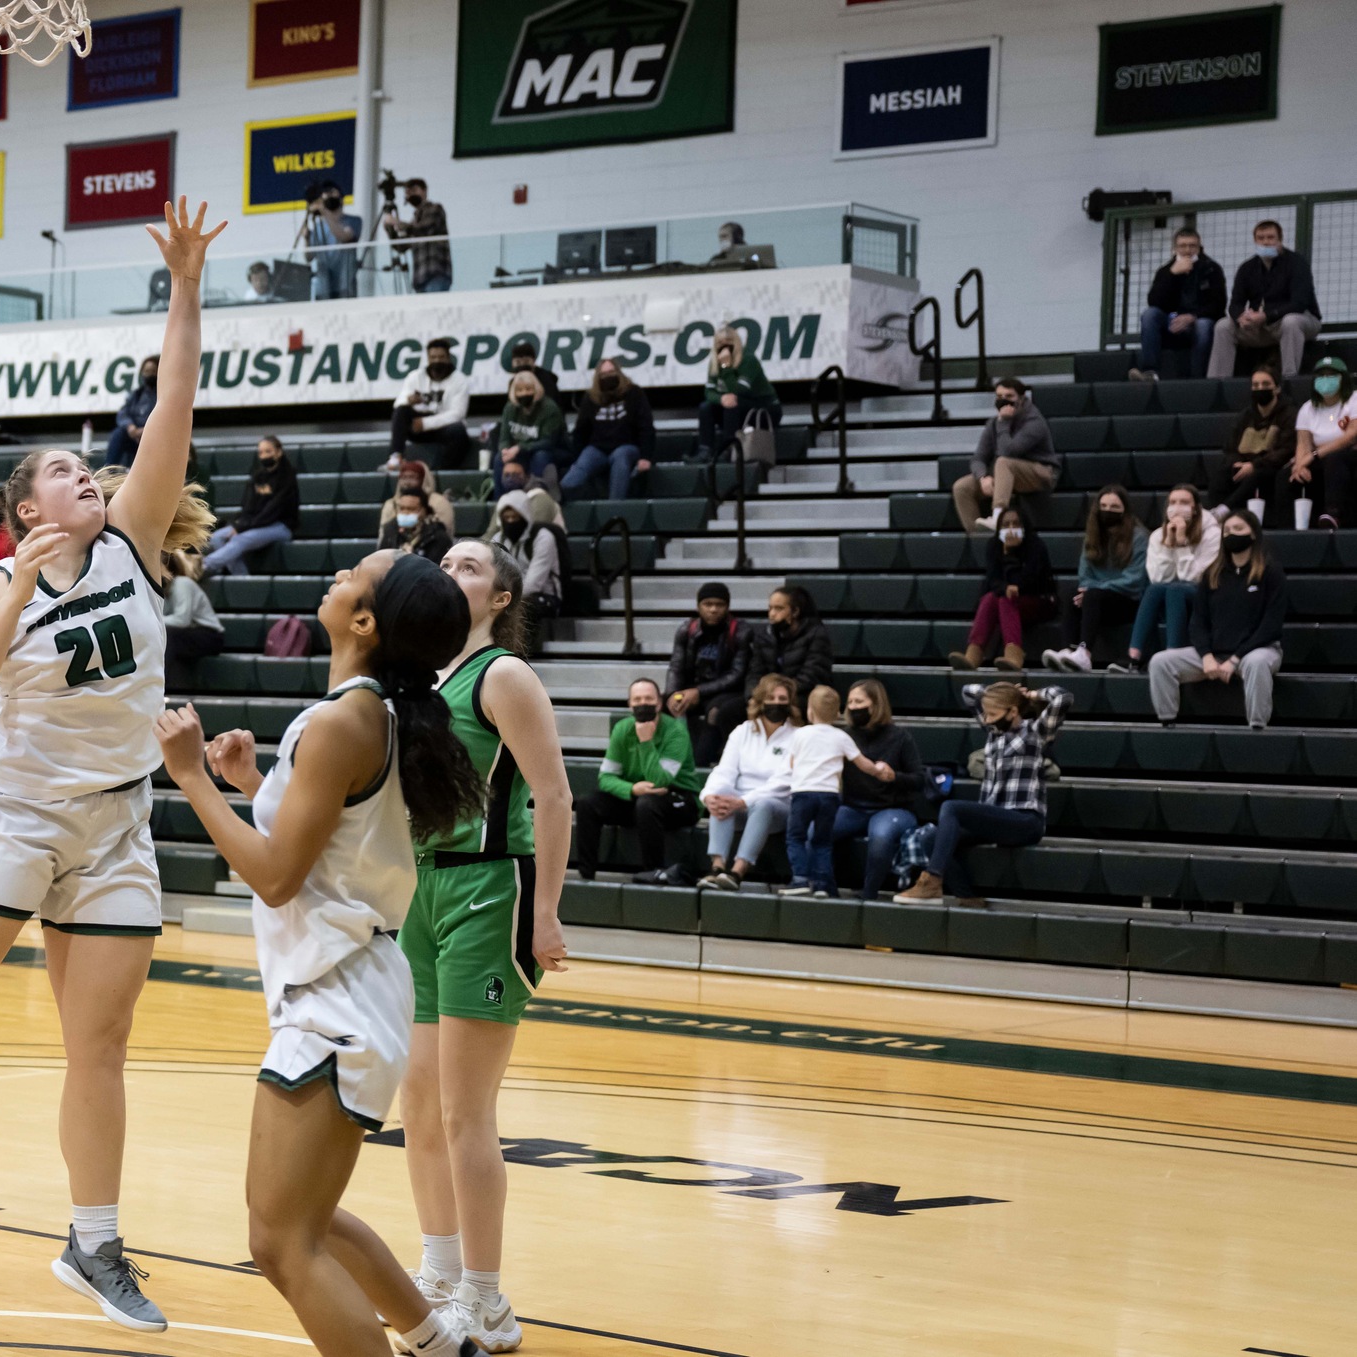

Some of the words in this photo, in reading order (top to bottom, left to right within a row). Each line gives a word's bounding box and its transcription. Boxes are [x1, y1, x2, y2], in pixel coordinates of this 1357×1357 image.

[93, 29, 161, 52] AIRLEIGH
[282, 22, 336, 46] KING'S
[510, 43, 667, 110] MAC
[1115, 52, 1262, 91] STEVENSON
[869, 84, 962, 115] MESSIAH
[273, 149, 336, 174] WILKES
[83, 169, 156, 196] STEVENS
[54, 614, 137, 688] 20
